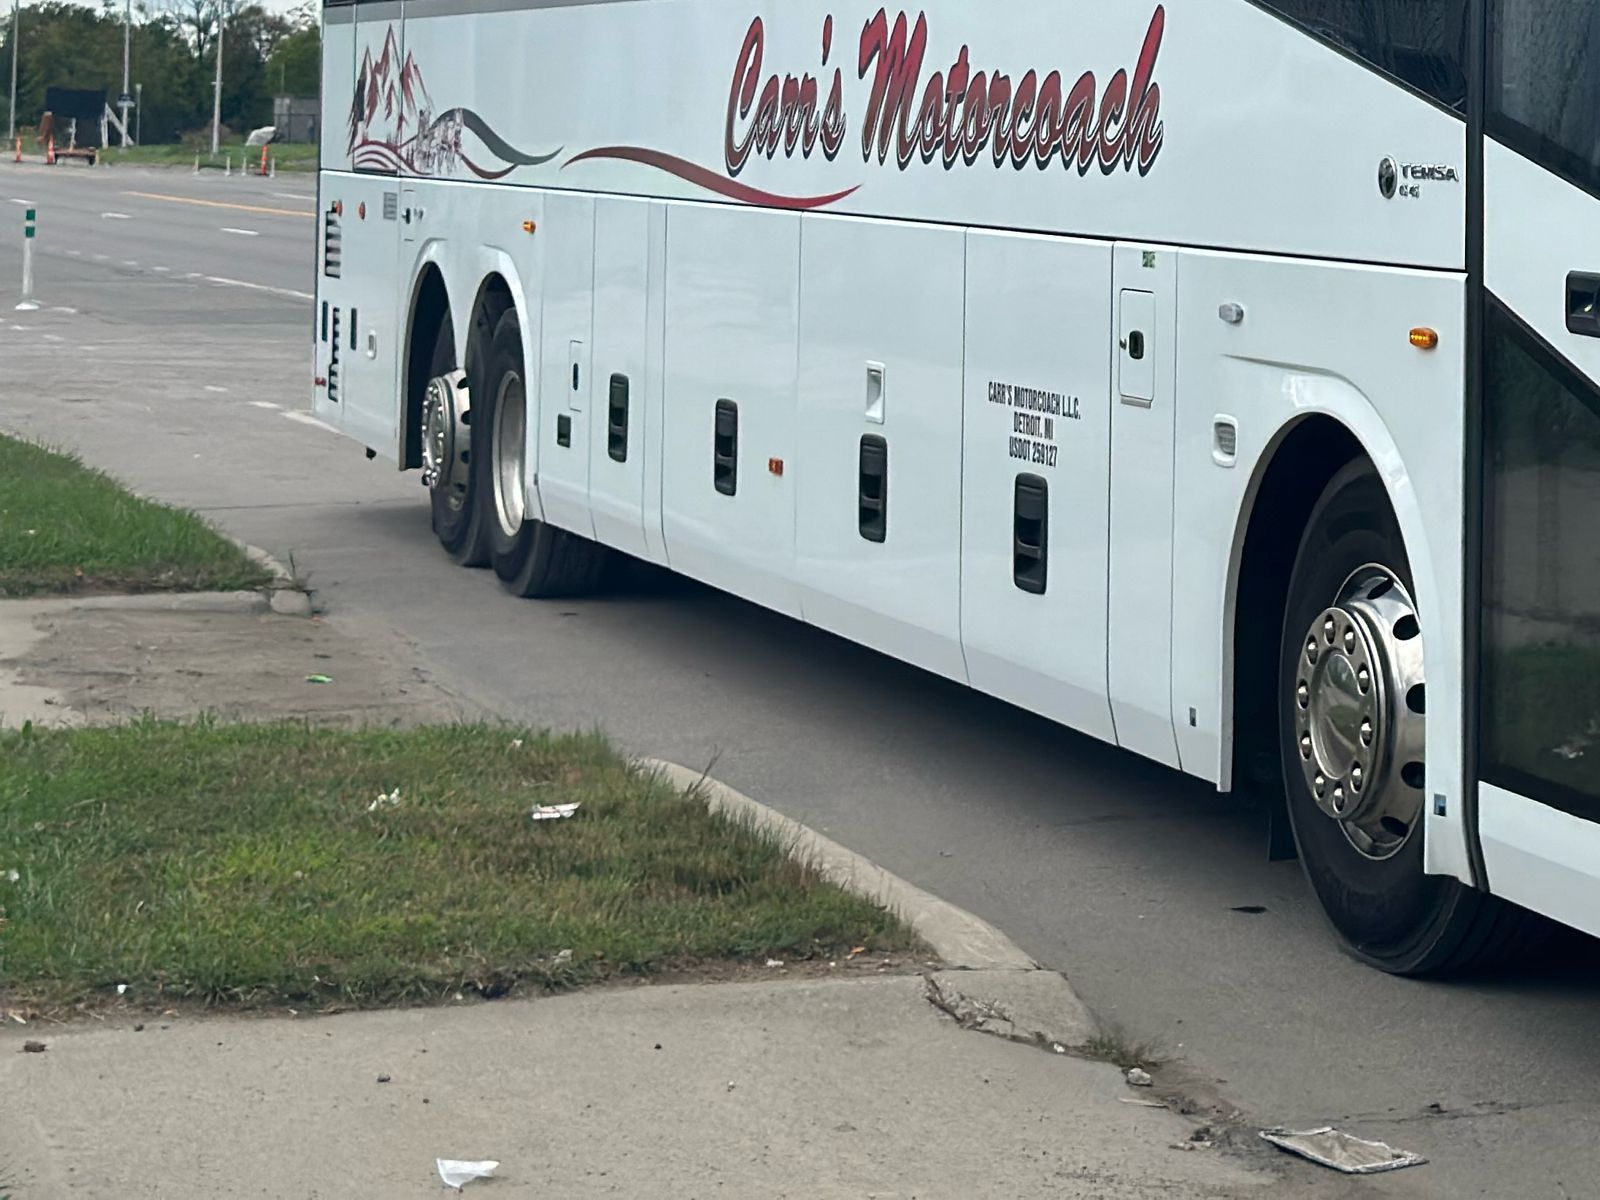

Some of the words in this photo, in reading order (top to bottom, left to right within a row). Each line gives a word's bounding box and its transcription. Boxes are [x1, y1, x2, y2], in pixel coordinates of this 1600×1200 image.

[724, 13, 846, 178] Carr's
[857, 3, 1165, 177] Motorcoach
[1400, 163, 1460, 183] TEMSA
[988, 380, 1013, 406] CARR'S
[1013, 385, 1061, 416] MOTORCOACH
[1044, 417, 1054, 440] MI
[1008, 435, 1031, 461] USDOT
